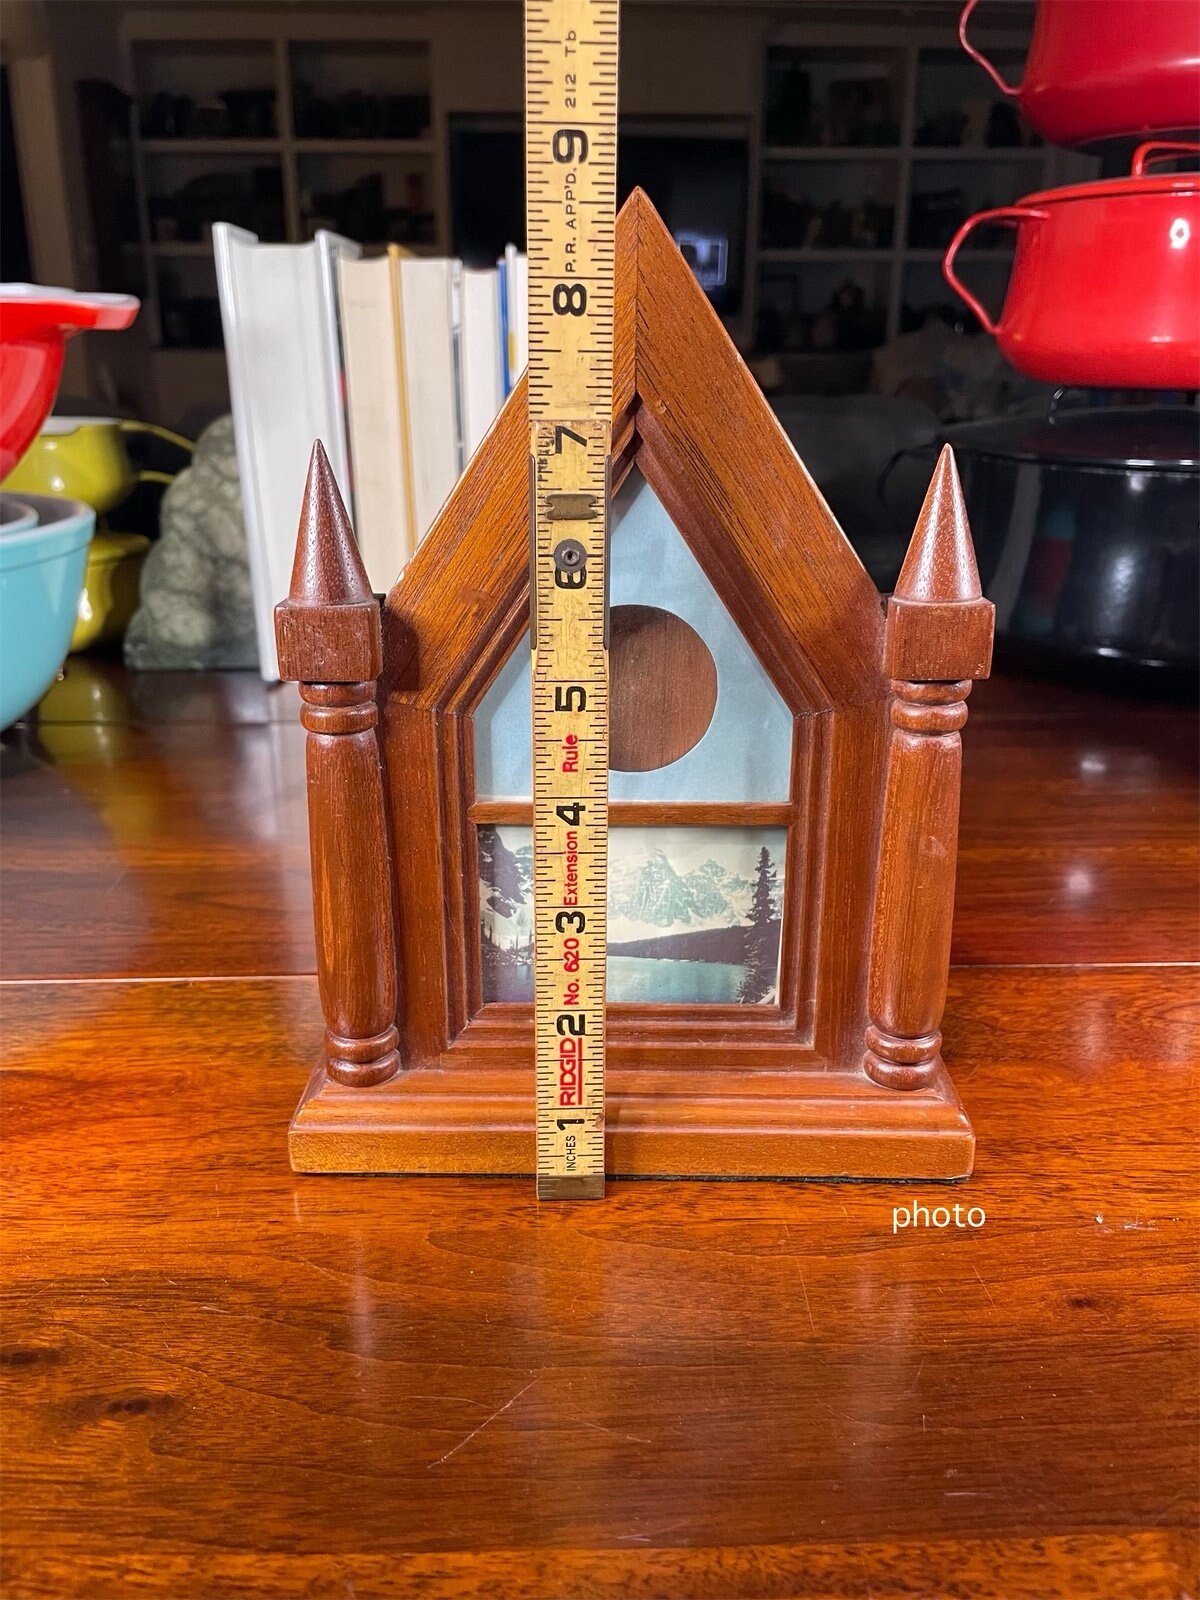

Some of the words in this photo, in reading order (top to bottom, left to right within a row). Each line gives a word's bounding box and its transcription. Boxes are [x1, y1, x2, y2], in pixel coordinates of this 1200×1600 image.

[565, 73, 577, 108] 212
[552, 128, 589, 164] 9
[552, 283, 587, 317] 8
[555, 425, 587, 454] 7
[555, 686, 587, 712] 5
[562, 734, 579, 773] Rule
[556, 802, 586, 827] 4
[563, 831, 578, 906] Extension
[555, 911, 586, 934] 3
[563, 937, 580, 973] 620
[563, 978, 580, 1006] No.
[556, 1014, 586, 1036] 2
[560, 1037, 577, 1106] RIDGID
[556, 1118, 585, 1131] 1
[566, 1135, 576, 1171] INCHES
